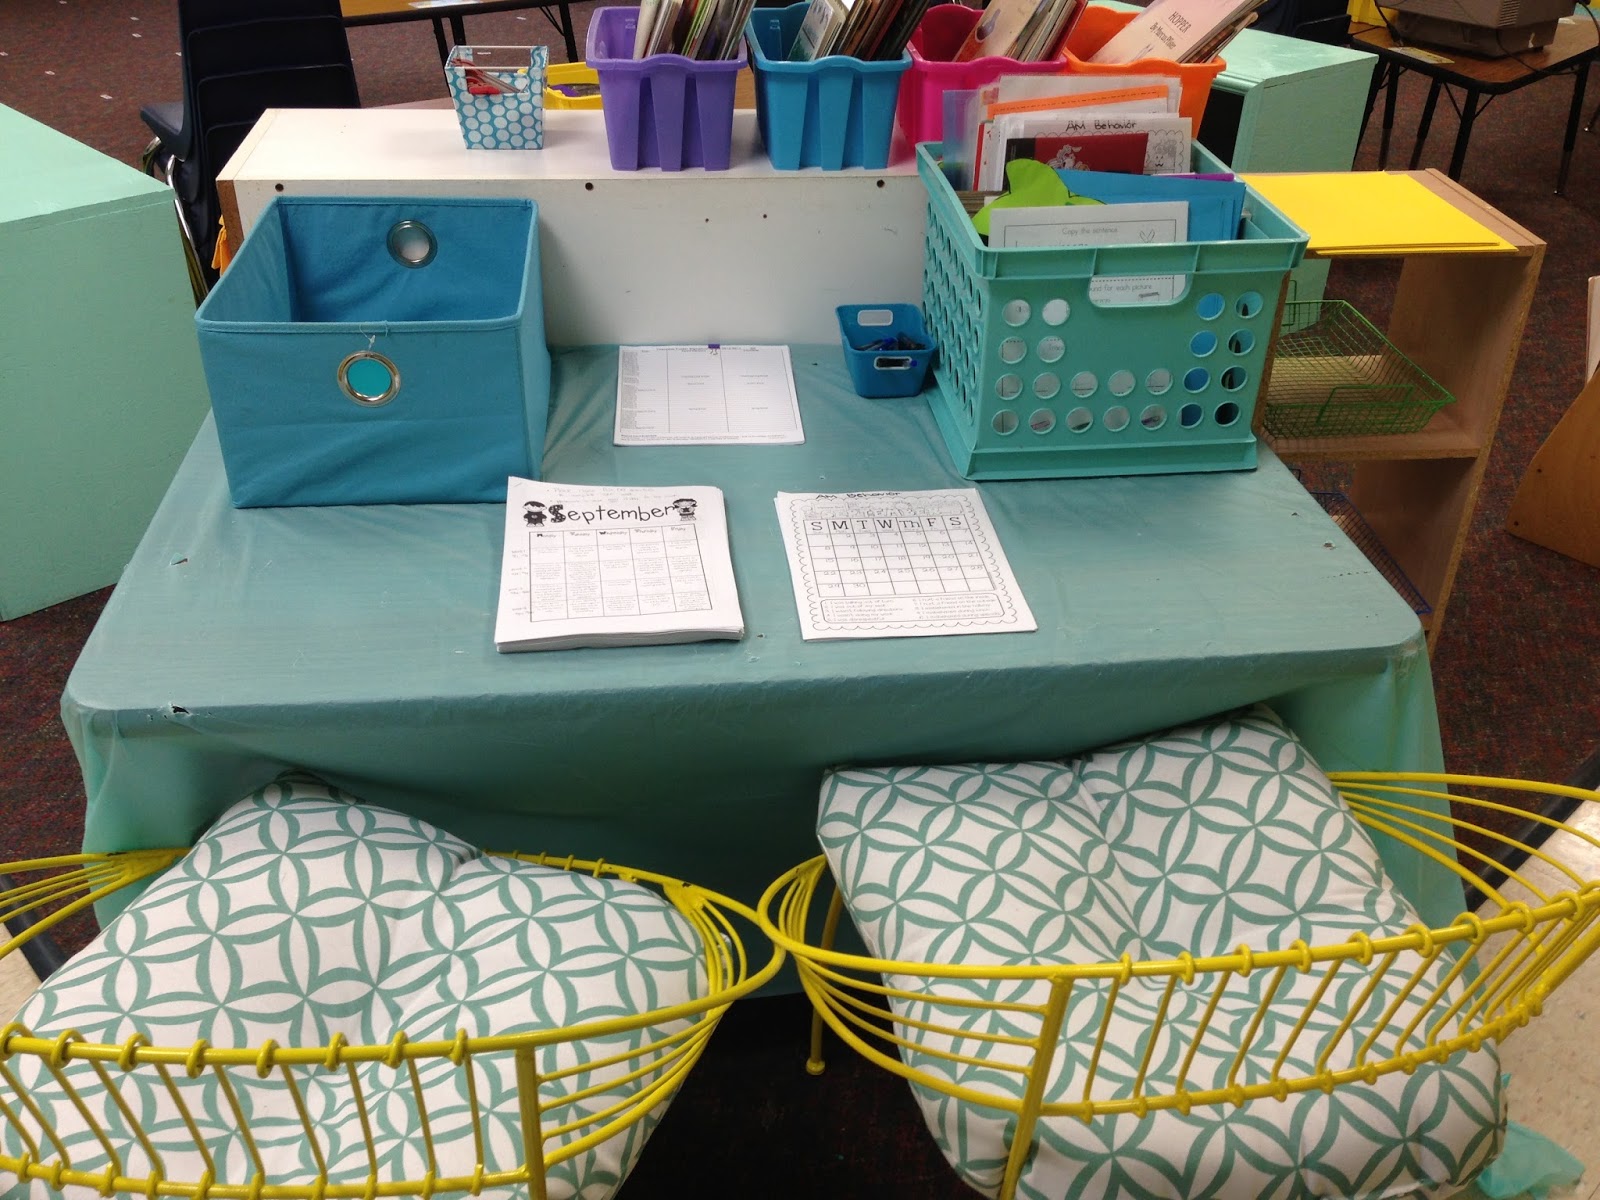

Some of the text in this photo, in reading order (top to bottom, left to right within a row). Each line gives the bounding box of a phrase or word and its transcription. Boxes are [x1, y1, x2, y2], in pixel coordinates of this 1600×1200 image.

[1168, 11, 1192, 34] HOPPER
[1065, 120, 1138, 132] AM Behavior
[1062, 228, 1078, 236] Copy
[549, 504, 676, 524] September
[811, 516, 962, 531] S M T W Th F S
